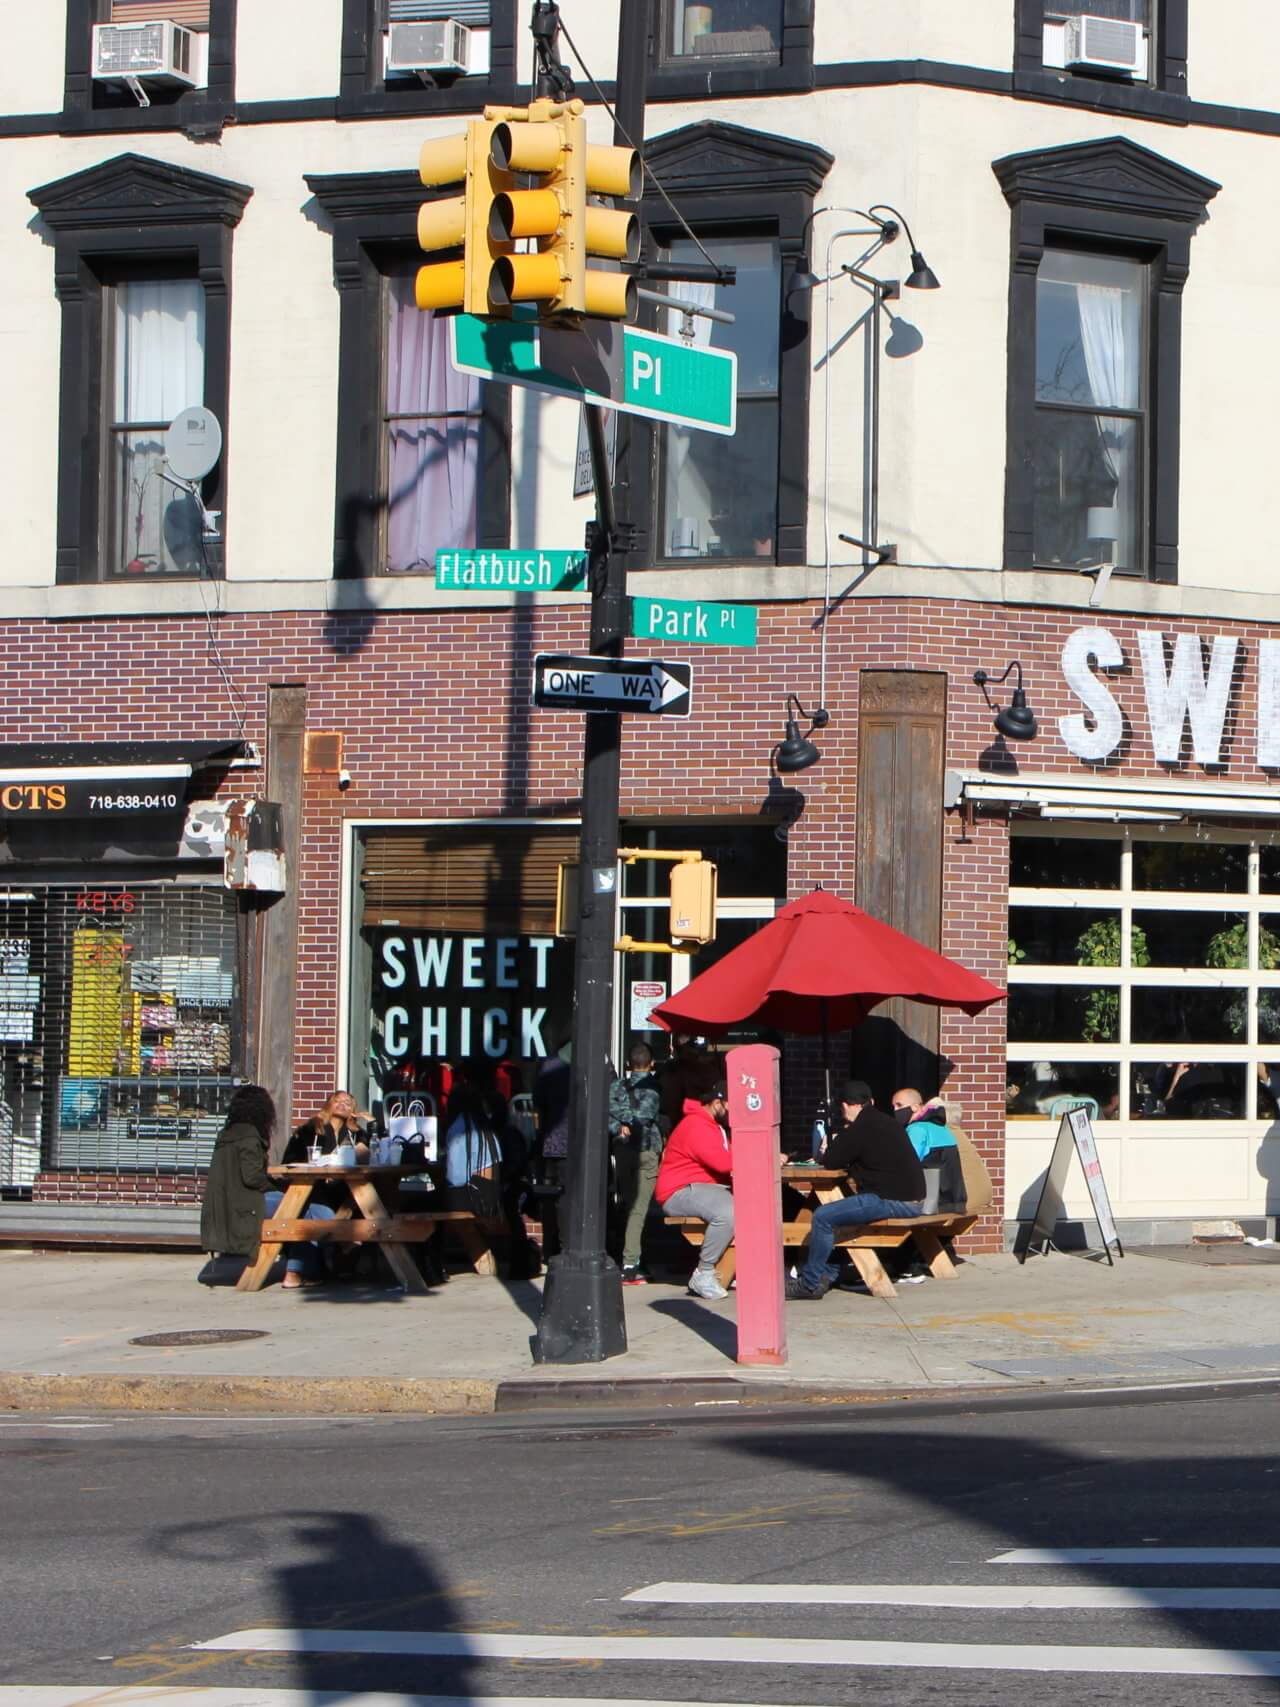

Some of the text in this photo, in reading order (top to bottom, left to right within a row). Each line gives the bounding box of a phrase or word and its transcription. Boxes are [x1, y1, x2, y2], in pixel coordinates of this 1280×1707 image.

[632, 351, 662, 396] Pl
[440, 553, 552, 586] Flatbush
[650, 604, 736, 638] Park Pl
[549, 672, 670, 698] ONE WAY
[1, 784, 177, 811] CTS 718-638-0410
[76, 892, 137, 913] KEYS
[381, 936, 555, 989] SWEET
[383, 1006, 548, 1059] CHICK
